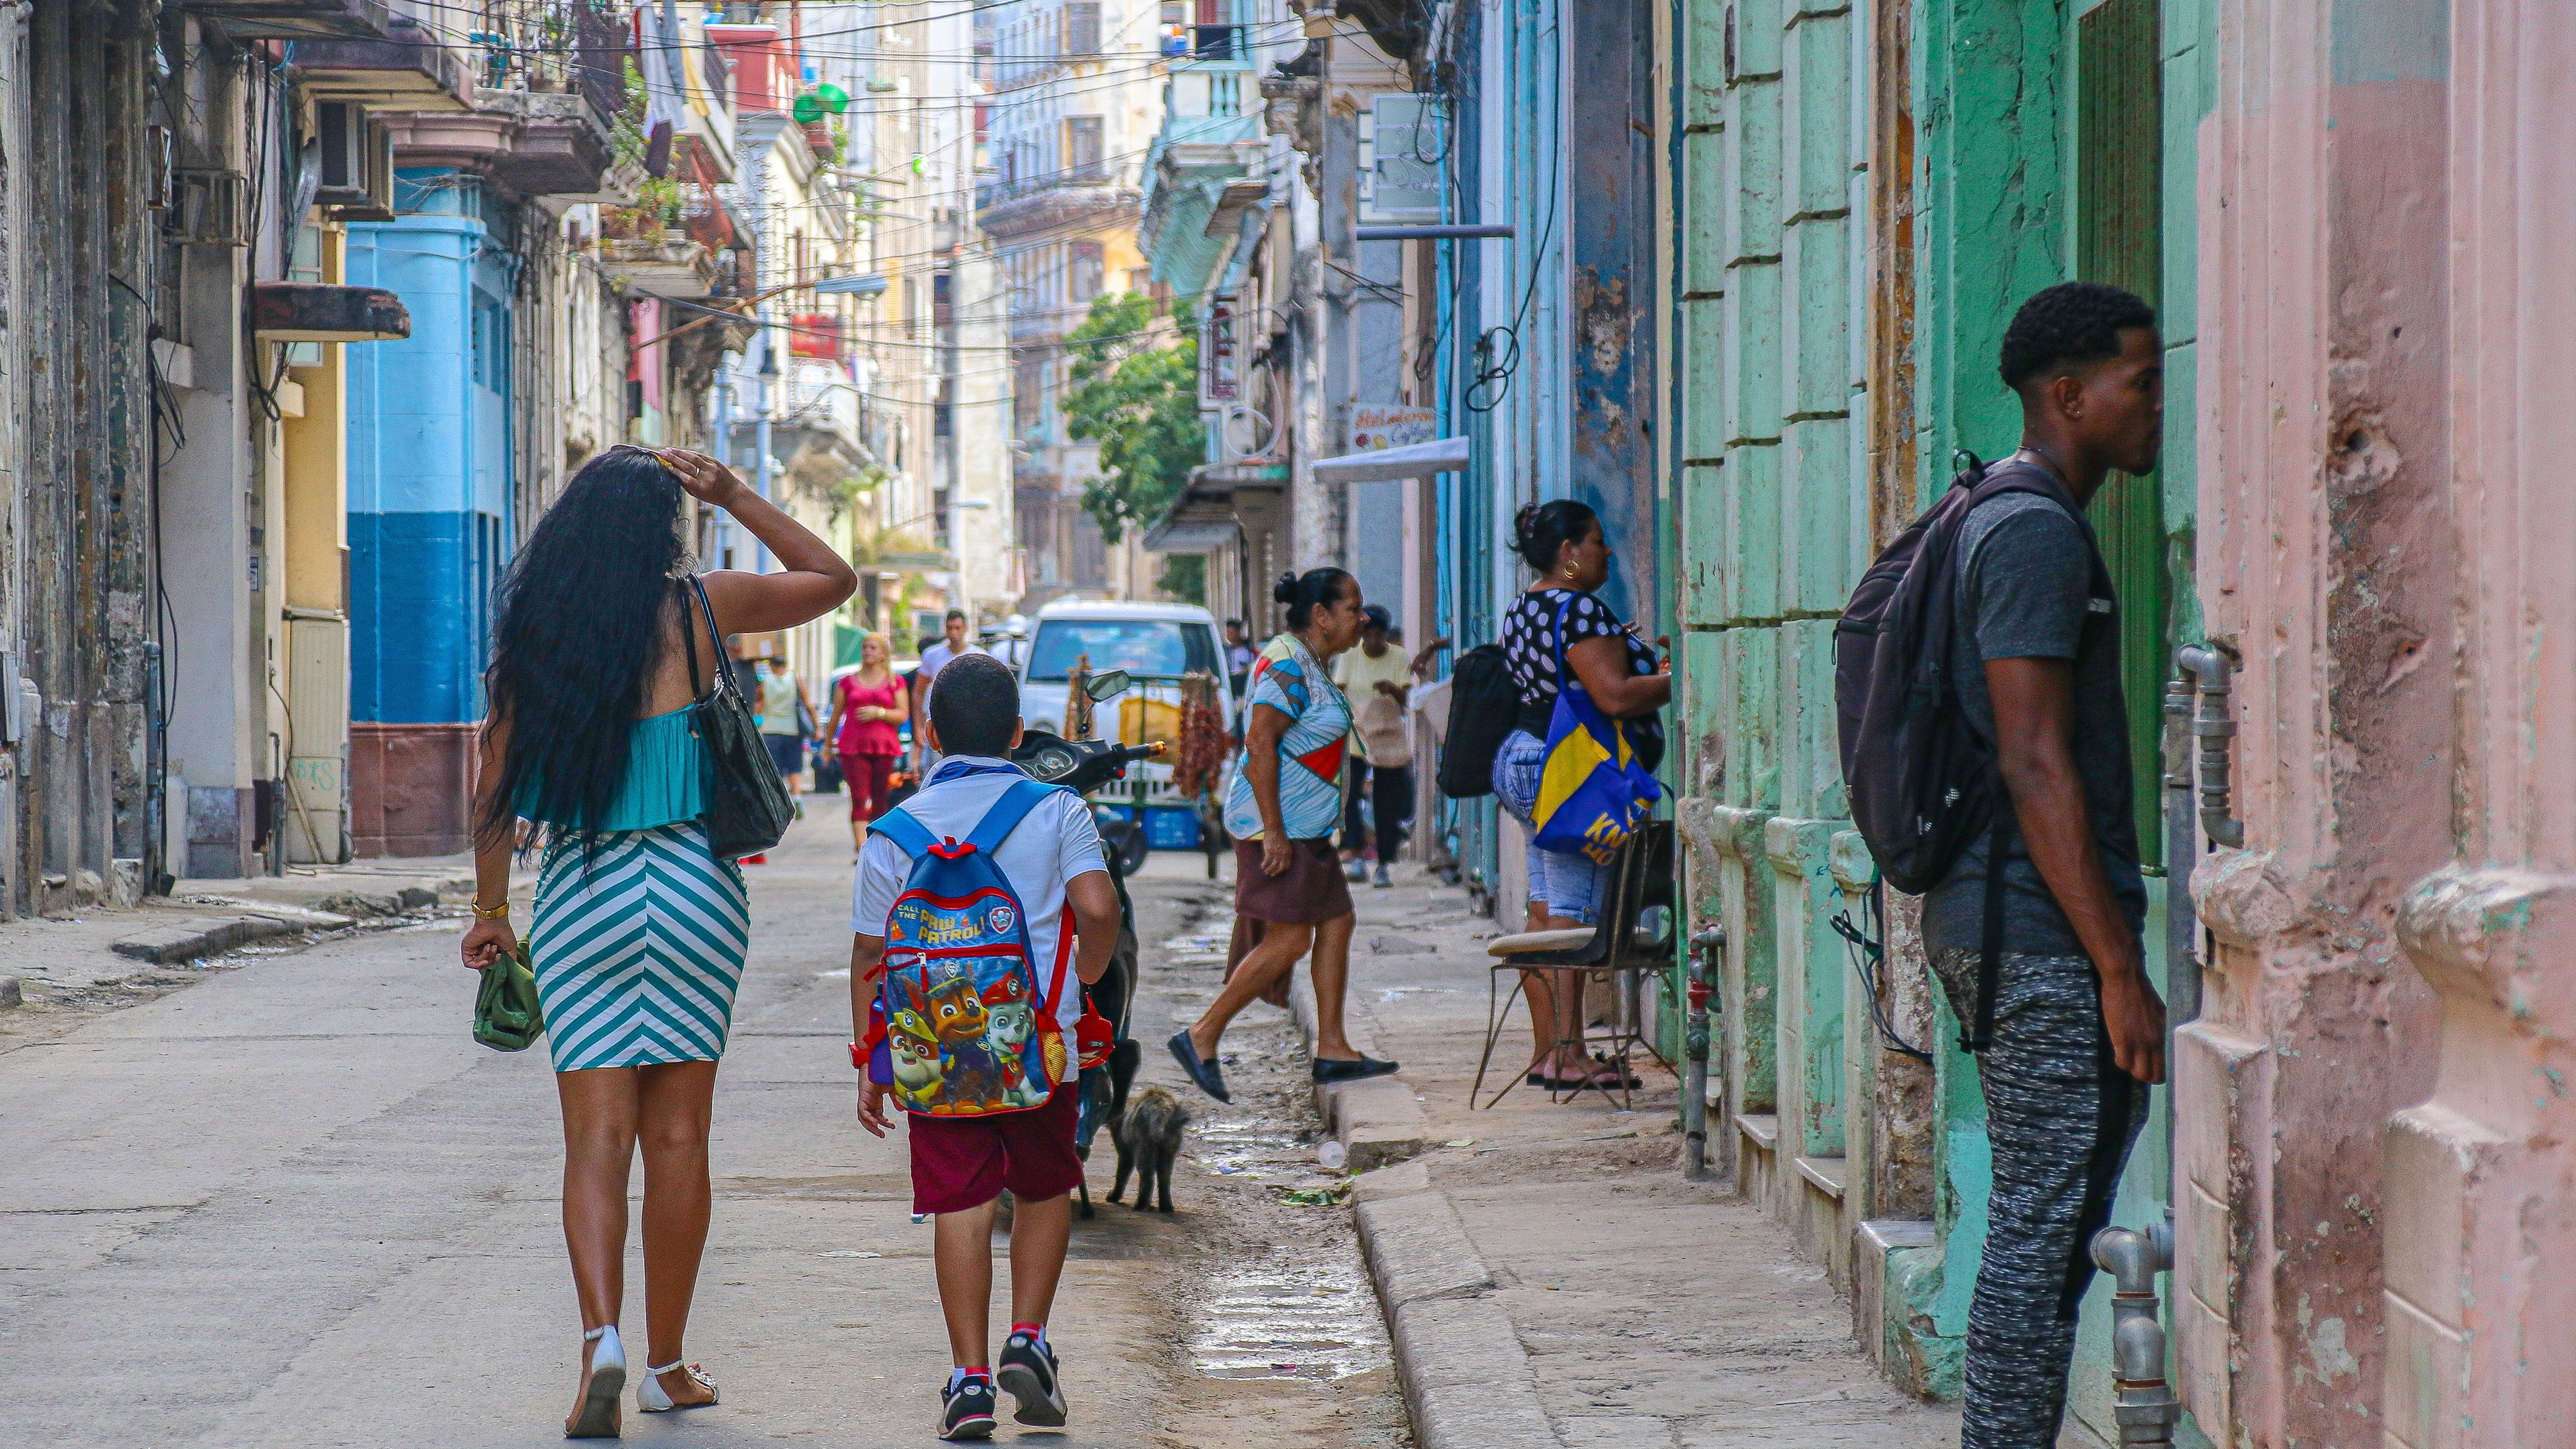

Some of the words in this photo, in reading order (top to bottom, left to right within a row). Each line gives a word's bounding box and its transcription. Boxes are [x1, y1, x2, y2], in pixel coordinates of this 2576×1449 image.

[897, 904, 920, 914] CALL
[899, 911, 917, 920] THE
[920, 909, 956, 930] PAW
[918, 916, 985, 944] PATROL!
